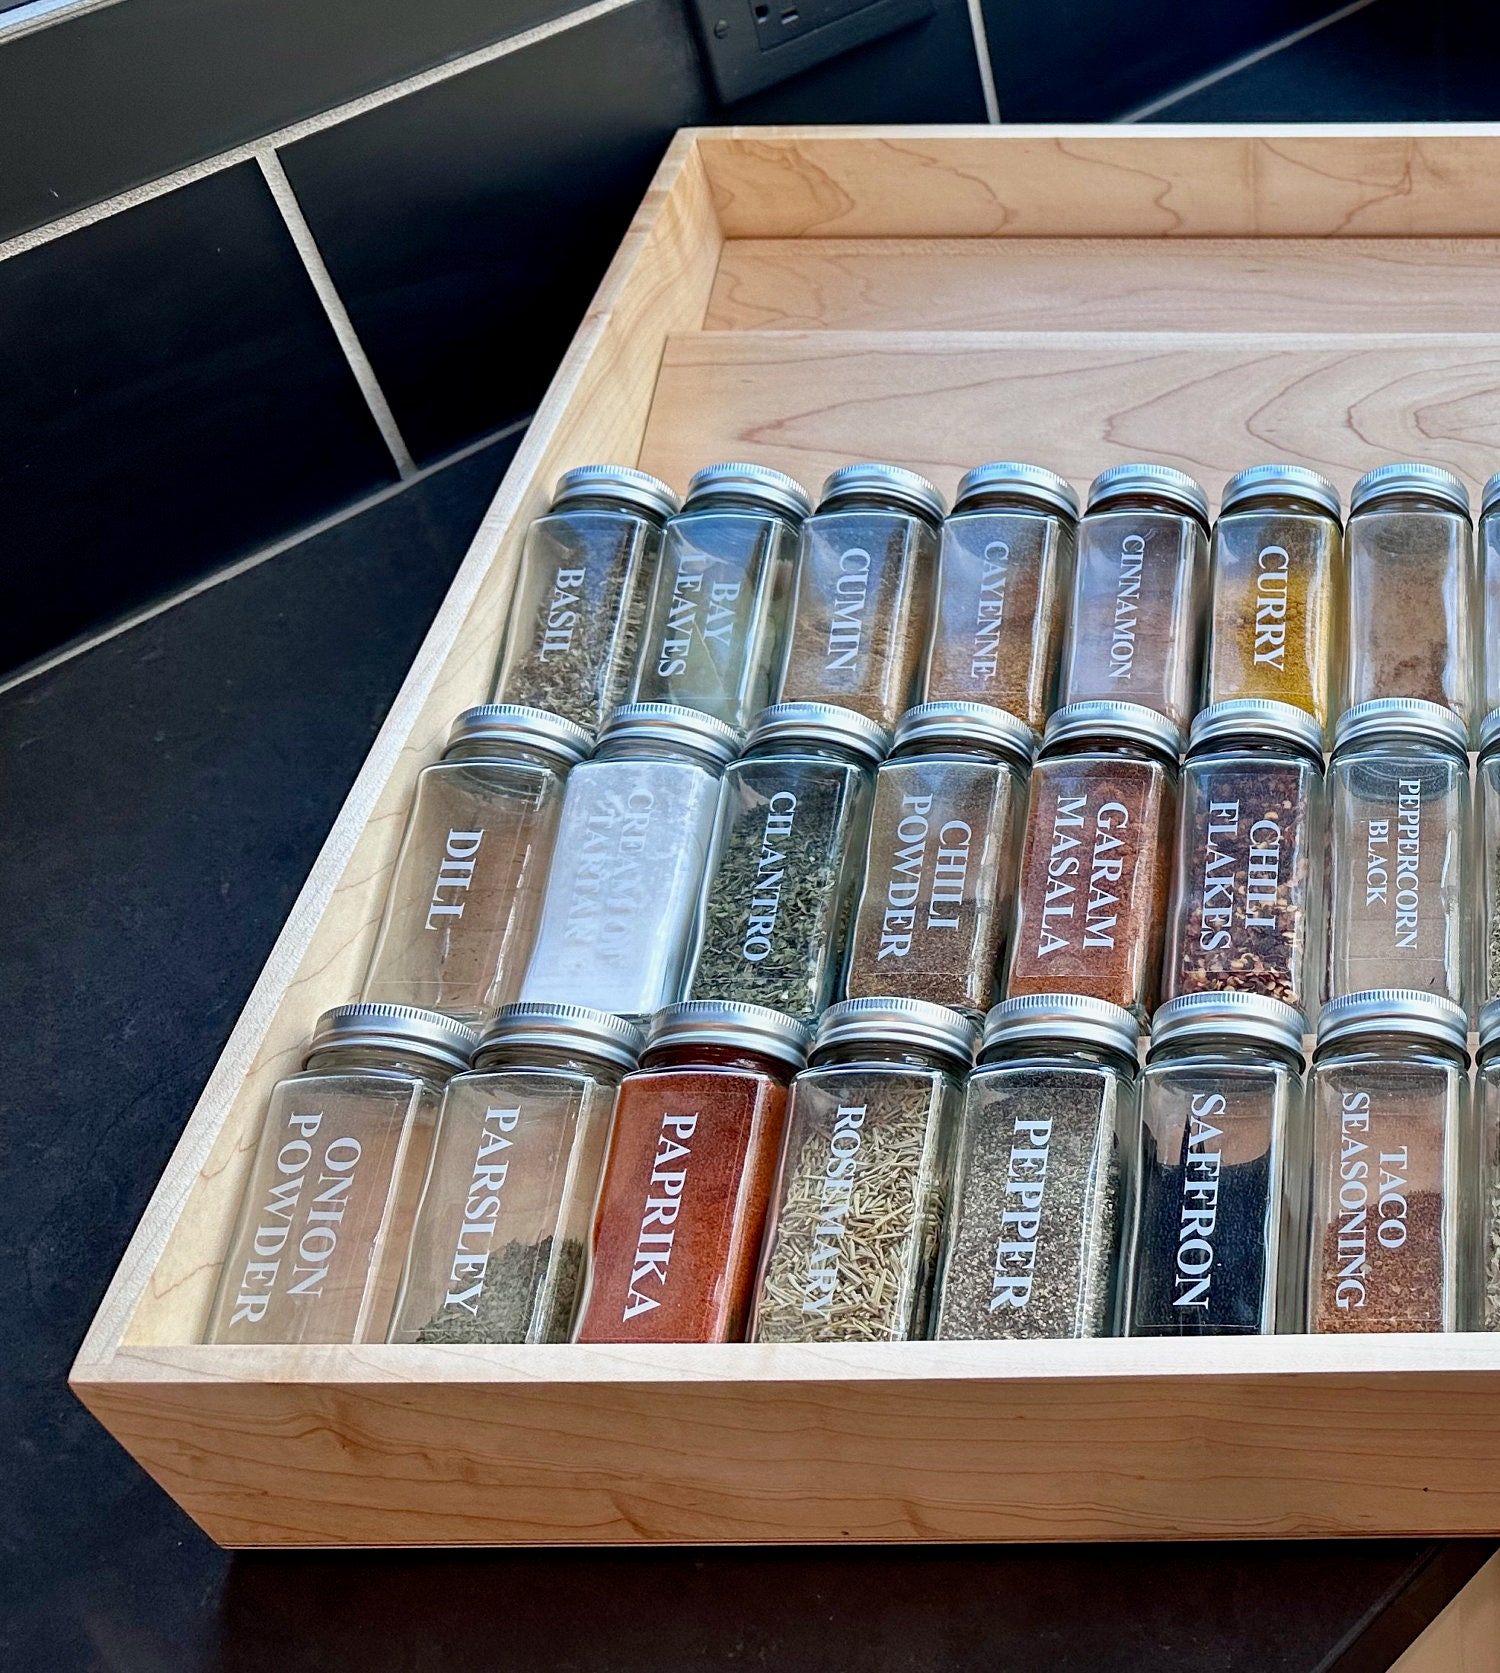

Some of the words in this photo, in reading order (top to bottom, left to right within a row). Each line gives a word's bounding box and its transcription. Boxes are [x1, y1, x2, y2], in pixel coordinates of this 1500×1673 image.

[539, 567, 586, 662] BASIL
[658, 554, 706, 677] LEAVES
[703, 581, 741, 646] BAY
[825, 547, 870, 672] CUMIN
[971, 540, 1009, 679] CAYENNE
[1108, 534, 1145, 679] CINNAMON
[1253, 545, 1289, 671] CURRY
[425, 828, 486, 931] DILL
[564, 808, 616, 941] TARTAR
[606, 788, 654, 909] CREAM
[743, 791, 797, 962] CILANTRO
[877, 793, 933, 961] POWDER
[926, 820, 972, 931] CHILI
[1037, 793, 1088, 958] MASALA
[1083, 801, 1129, 950] GARAM
[1200, 799, 1240, 951] FLAKES
[1245, 819, 1281, 931] CHILI
[1366, 819, 1390, 906] BLACK
[1394, 778, 1421, 950] PEPPERCORN
[229, 1110, 324, 1328] POWDER
[286, 1136, 362, 1299] ONION
[444, 1104, 522, 1317] PARSLEY
[622, 1111, 698, 1323] PAPRIKA
[802, 1103, 867, 1320] ROSEMARY
[990, 1116, 1053, 1312] PEPPER
[1172, 1093, 1226, 1310] SAFFRON
[1334, 1091, 1371, 1310] SEASONING
[1376, 1144, 1408, 1249] TACO
